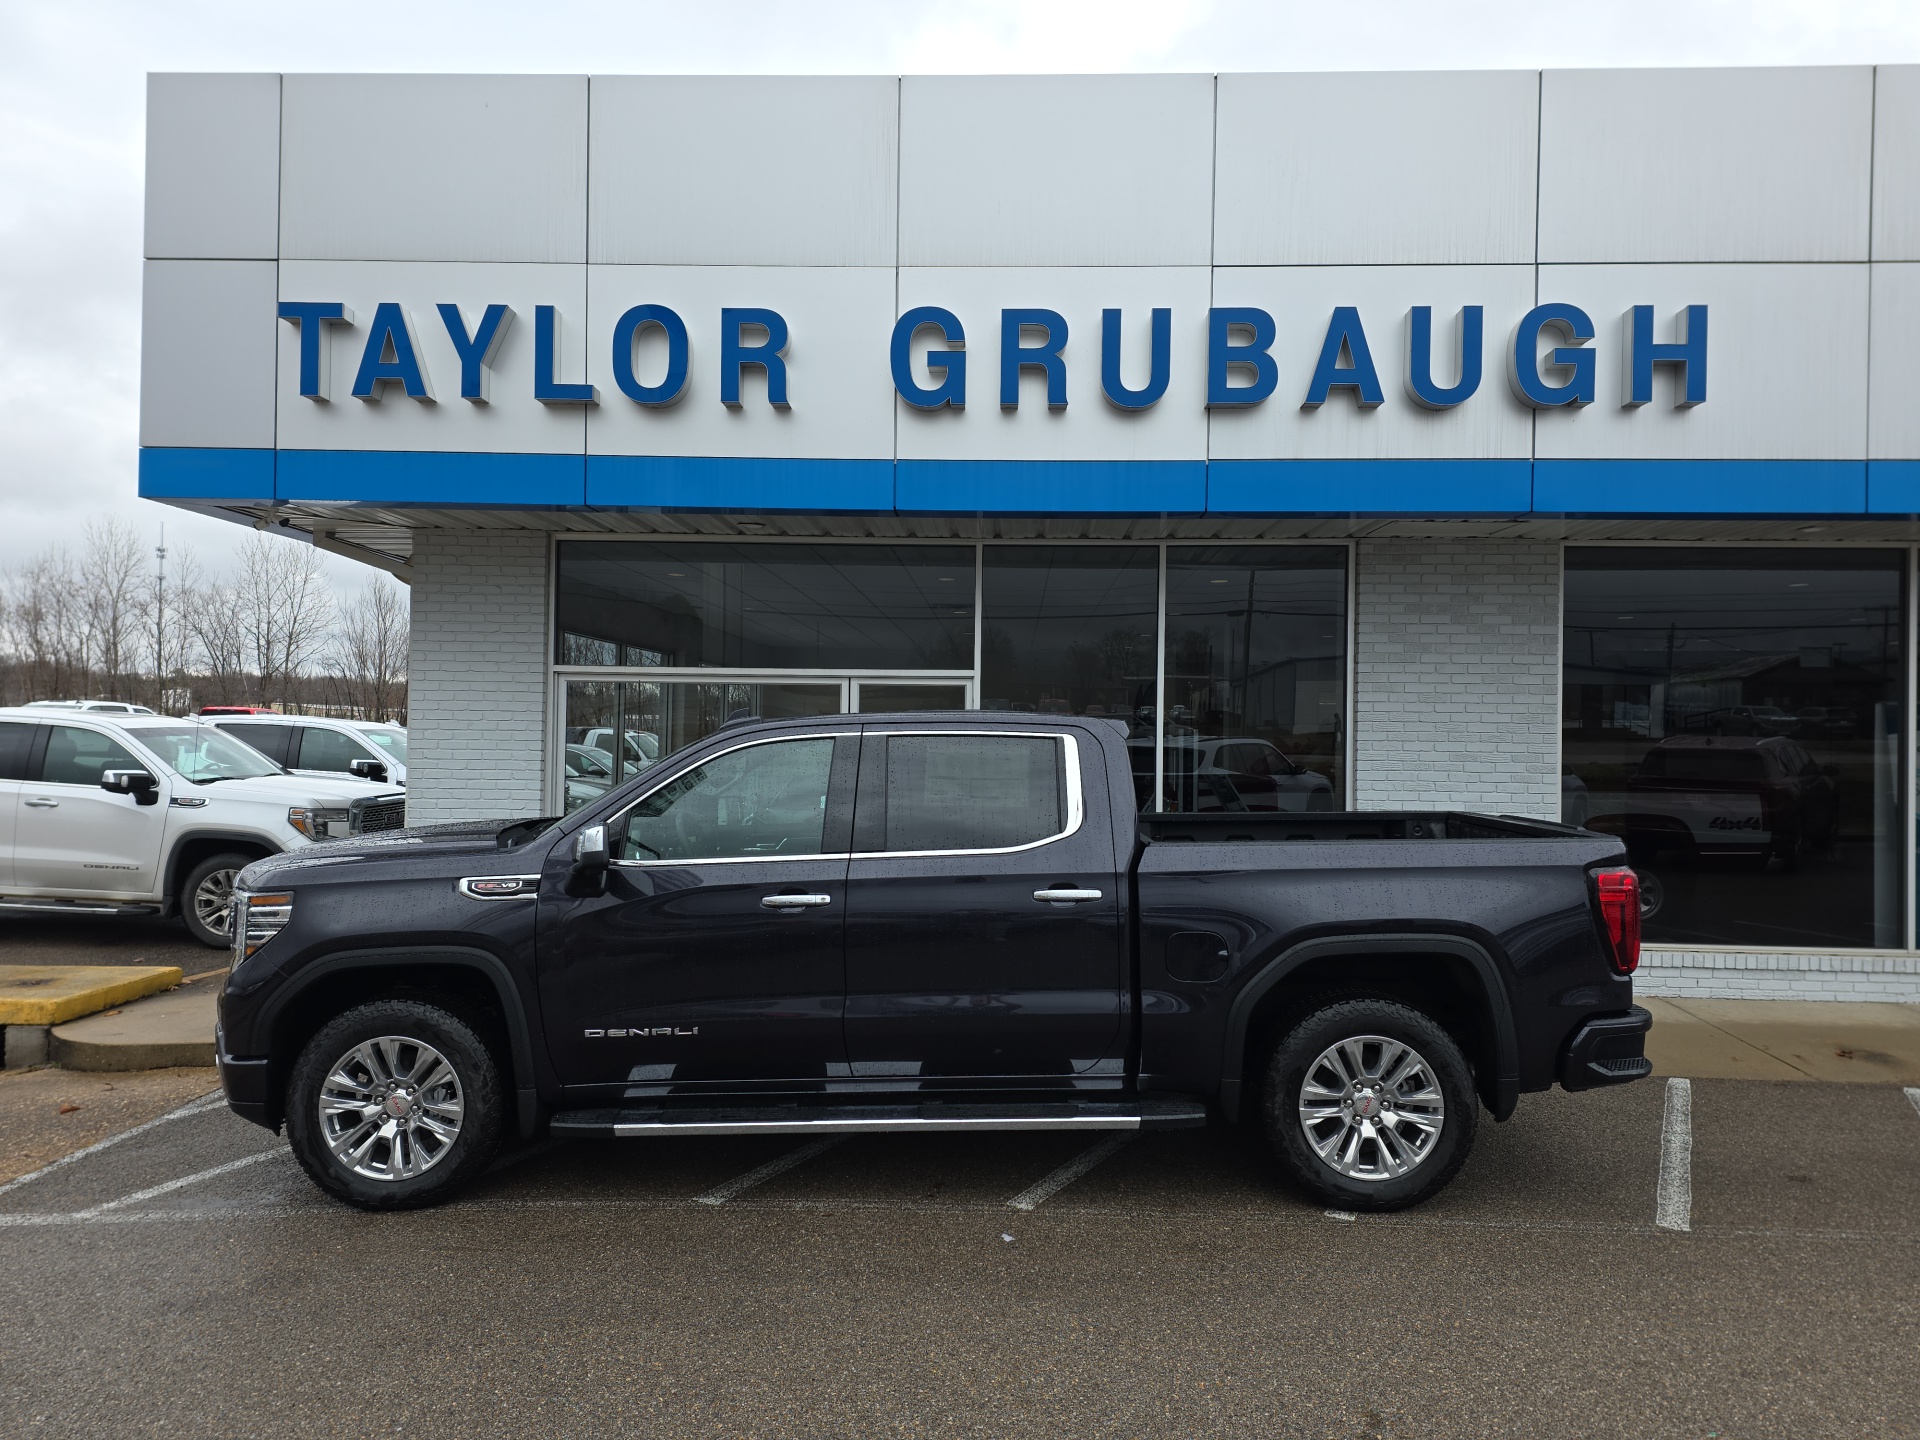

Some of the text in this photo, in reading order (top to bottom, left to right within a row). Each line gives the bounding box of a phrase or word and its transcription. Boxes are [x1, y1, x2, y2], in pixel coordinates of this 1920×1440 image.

[278, 302, 1708, 409] TAYLOR GRUBAUGH
[1709, 816, 1761, 830] 4x4
[584, 1027, 698, 1037] DENALI
[1363, 1096, 1373, 1113] GMC
